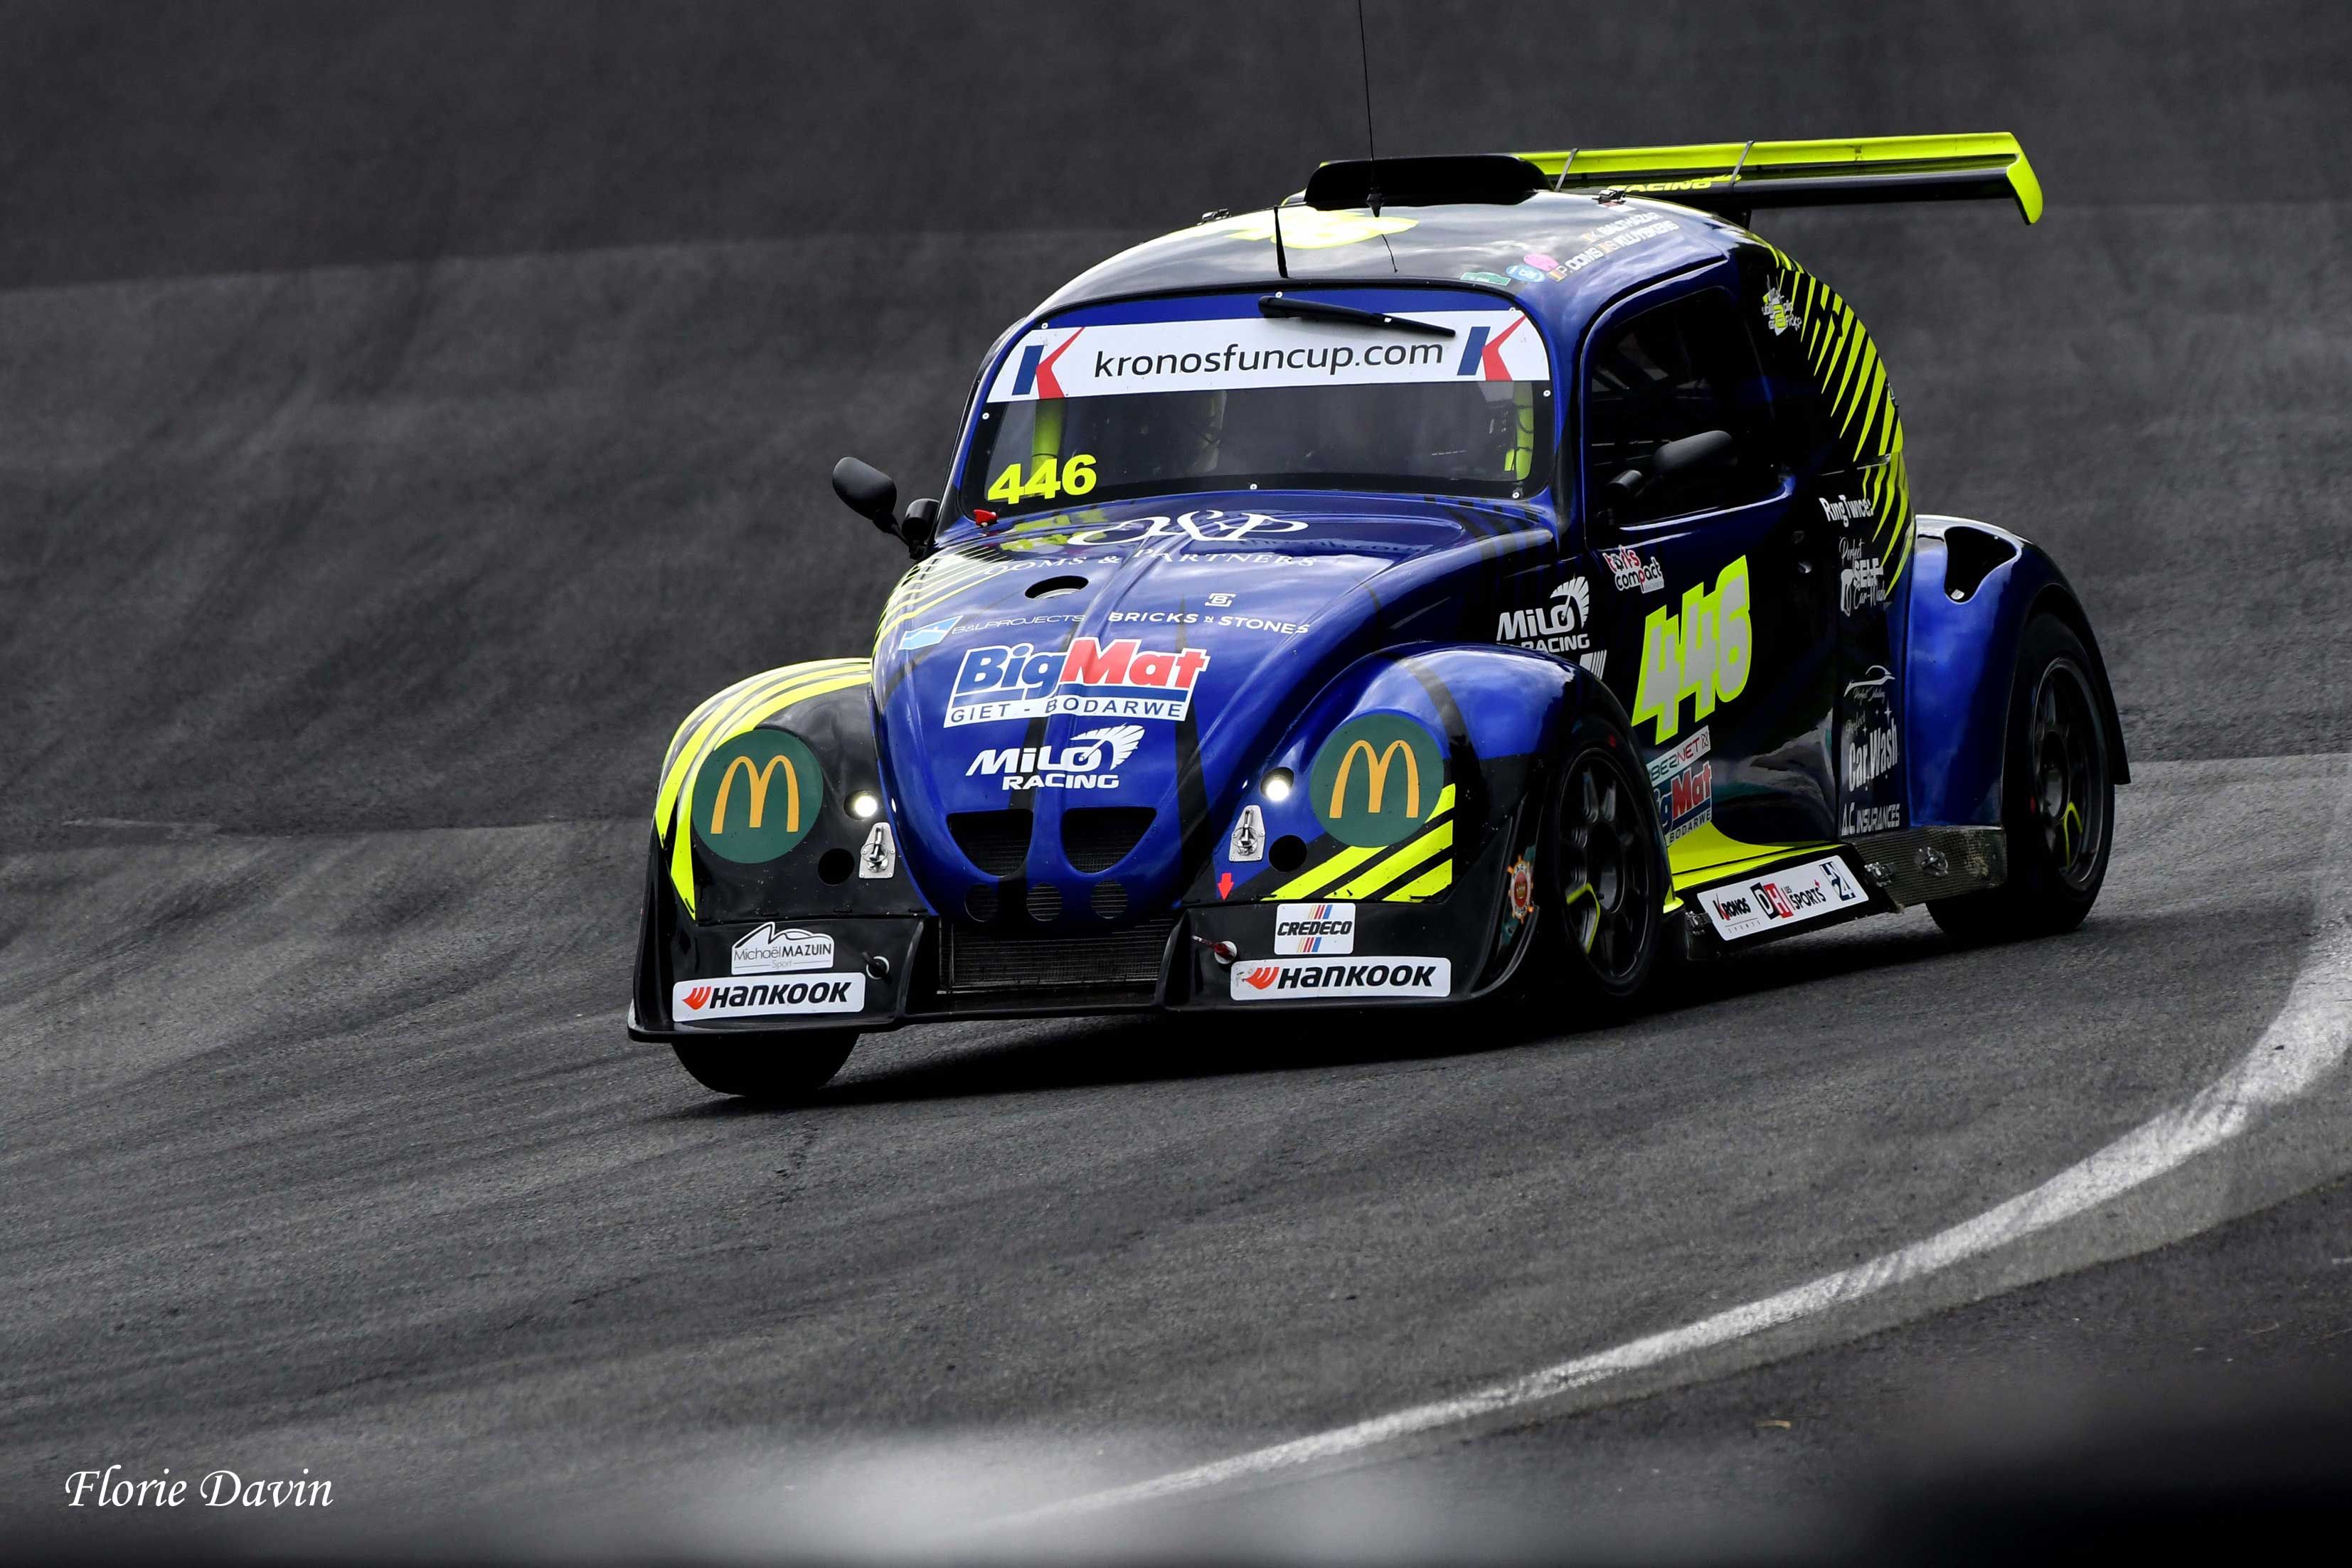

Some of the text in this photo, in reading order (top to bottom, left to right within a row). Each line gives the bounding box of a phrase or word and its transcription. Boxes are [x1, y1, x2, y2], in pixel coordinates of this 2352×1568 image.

[1095, 343, 1443, 378] kronosfuncup.com
[987, 454, 1097, 504] 446
[1135, 548, 1317, 567] PARTNERS
[1615, 557, 1663, 592] compact
[1107, 612, 1198, 624] BRICKS
[1218, 616, 1311, 634] STONES
[1632, 555, 1752, 745] 446
[954, 638, 1208, 700] BigMat
[951, 703, 1011, 722] GIET
[1045, 698, 1183, 718] BODARWE
[1869, 718, 1898, 780] Wash
[1001, 774, 1119, 791] RACING
[1789, 887, 1826, 910] SPORTS
[1277, 921, 1352, 937] CREDECO
